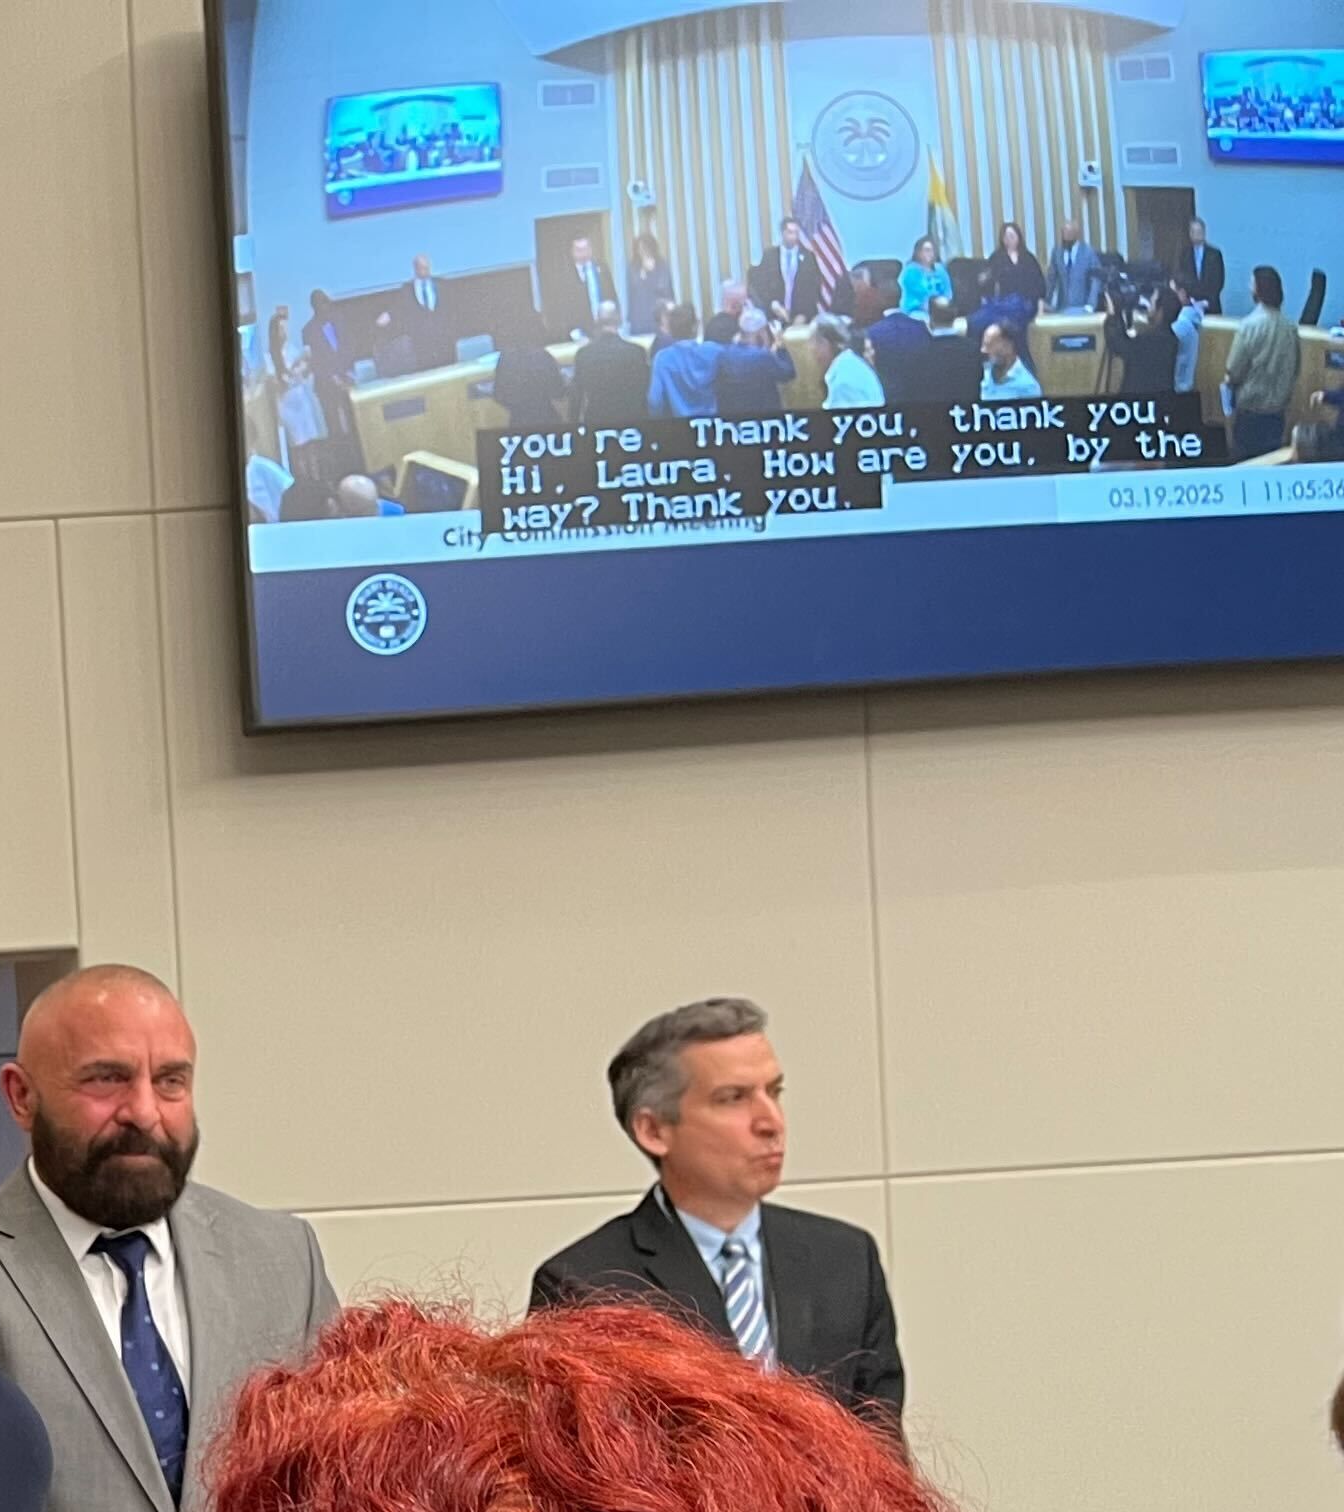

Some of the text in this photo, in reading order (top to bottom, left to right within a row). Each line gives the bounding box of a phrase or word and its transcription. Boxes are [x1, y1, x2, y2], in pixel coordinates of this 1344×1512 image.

[499, 425, 659, 465] you're.
[689, 413, 810, 449] Thank
[949, 400, 1065, 433] thank
[762, 448, 835, 479] How
[856, 444, 928, 473] are
[1066, 433, 1110, 472] by
[1135, 430, 1203, 459] the
[502, 496, 600, 534] way?
[621, 489, 742, 524] Thank
[1108, 483, 1225, 510] 03.19.2025
